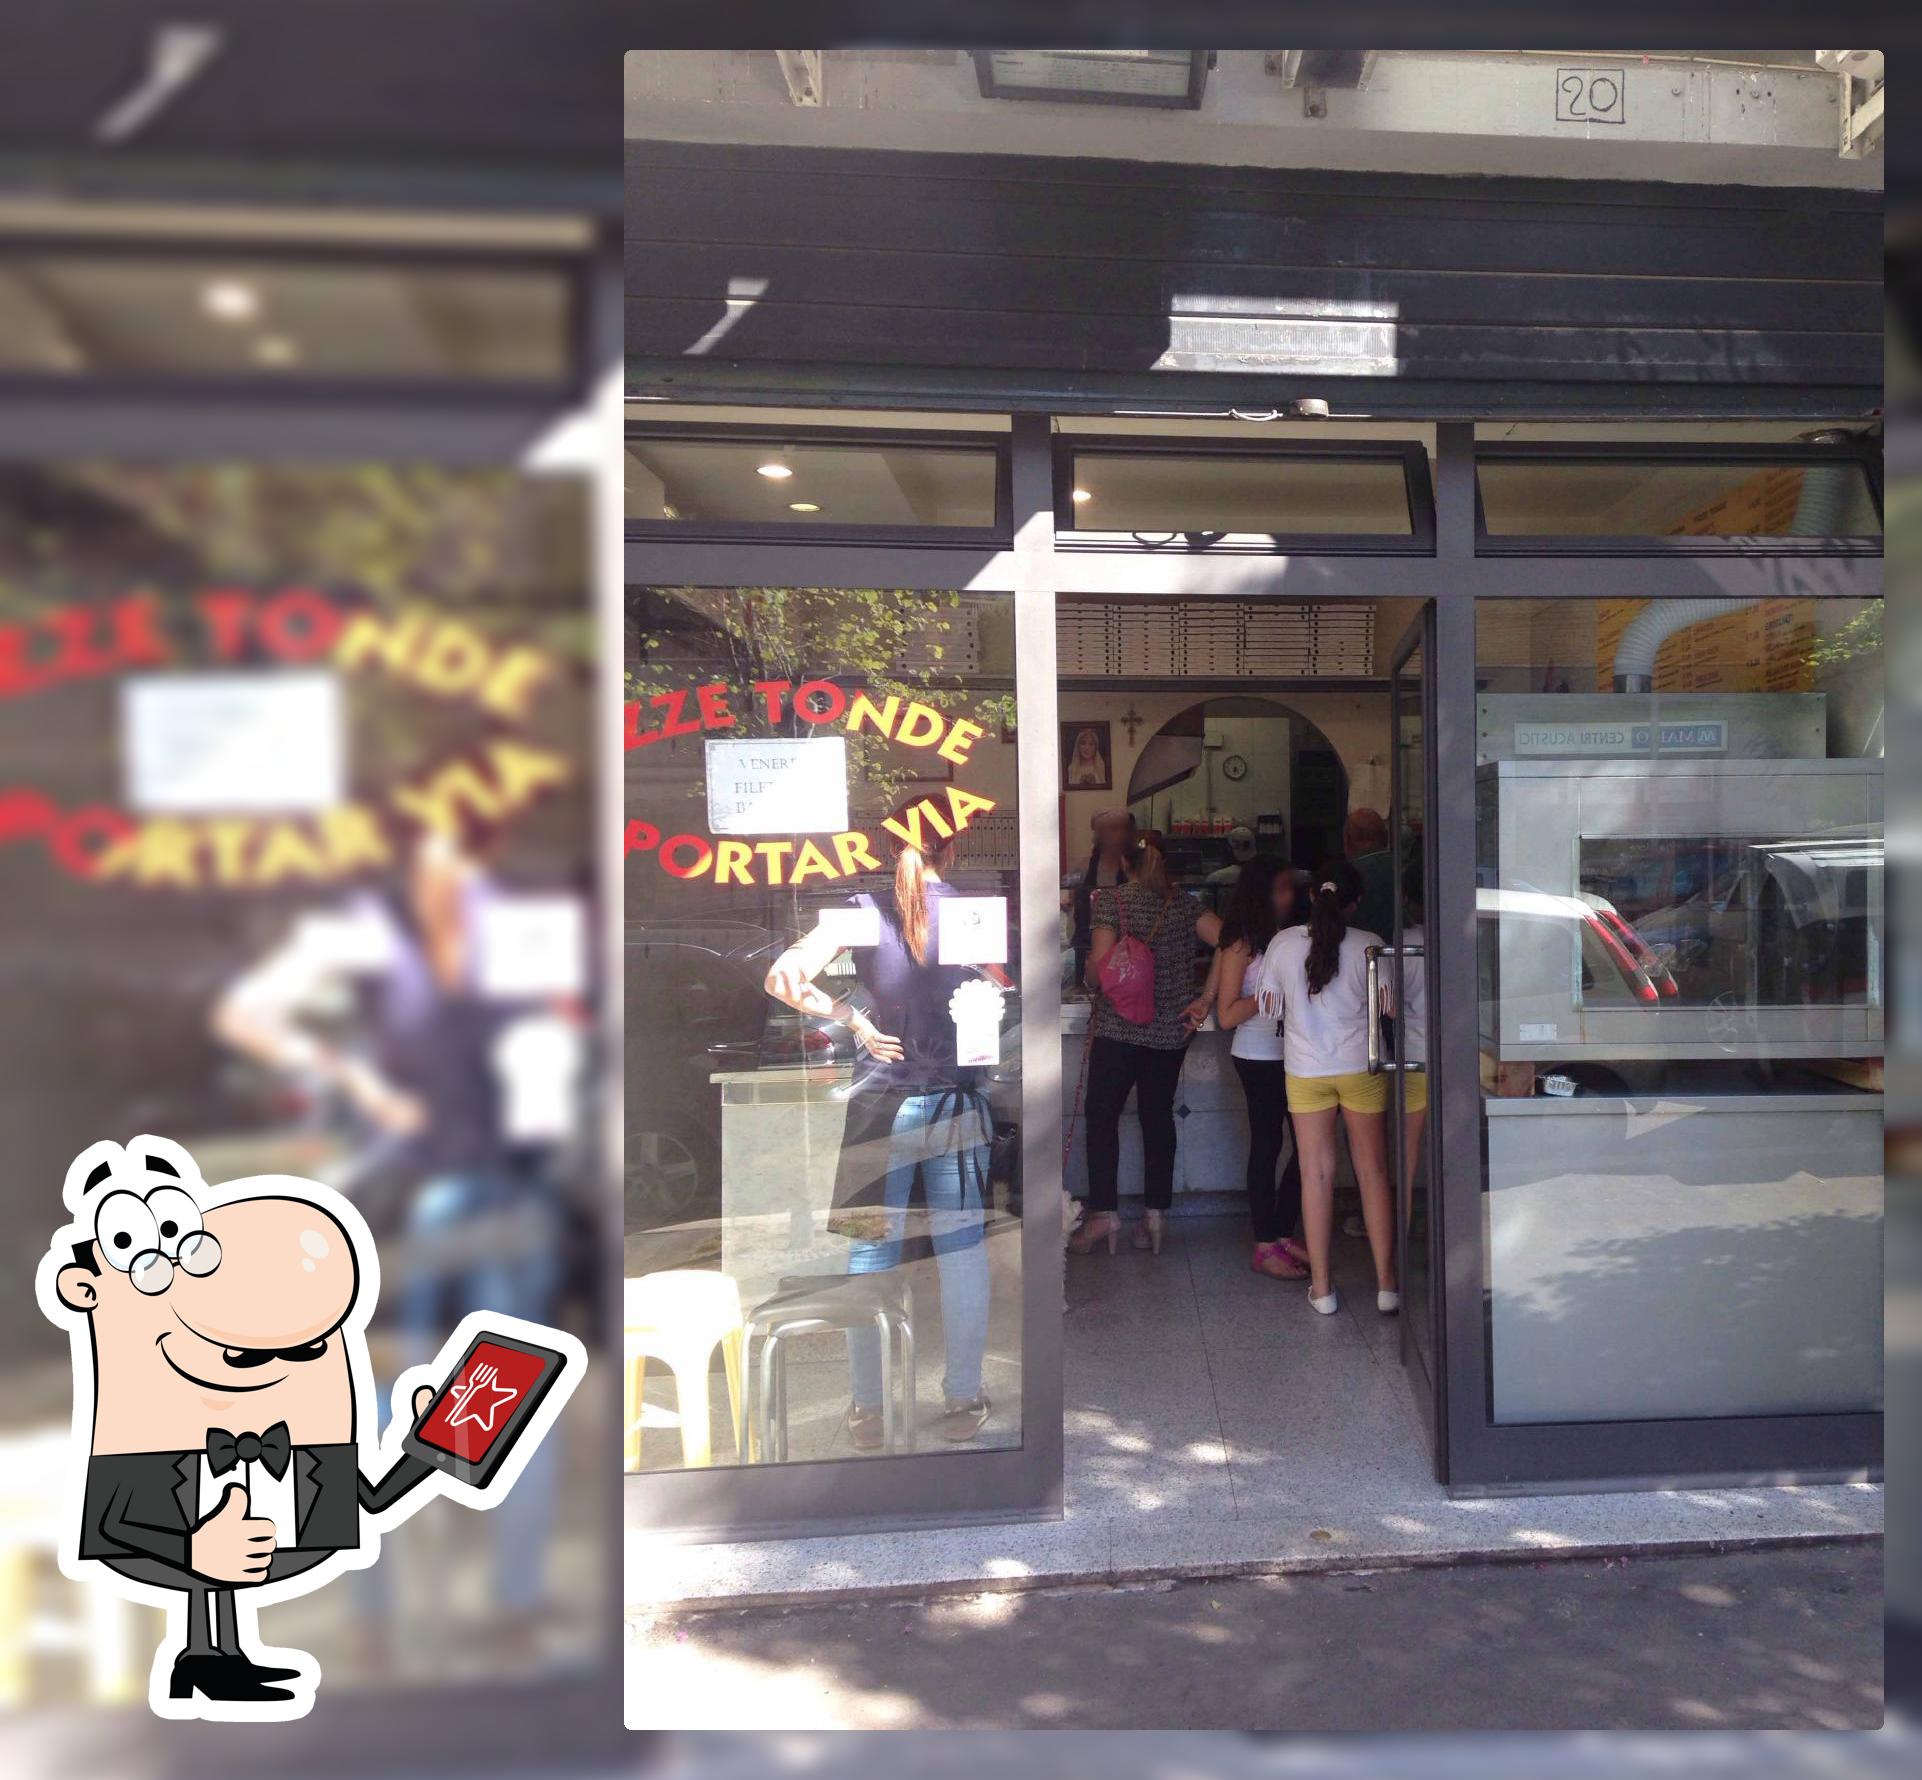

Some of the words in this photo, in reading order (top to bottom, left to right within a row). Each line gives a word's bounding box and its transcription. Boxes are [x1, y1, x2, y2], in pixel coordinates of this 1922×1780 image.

[1562, 75, 1618, 116] 20
[755, 680, 984, 766] TONDE
[624, 818, 882, 885] PORTAR
[881, 786, 996, 851] VIA
